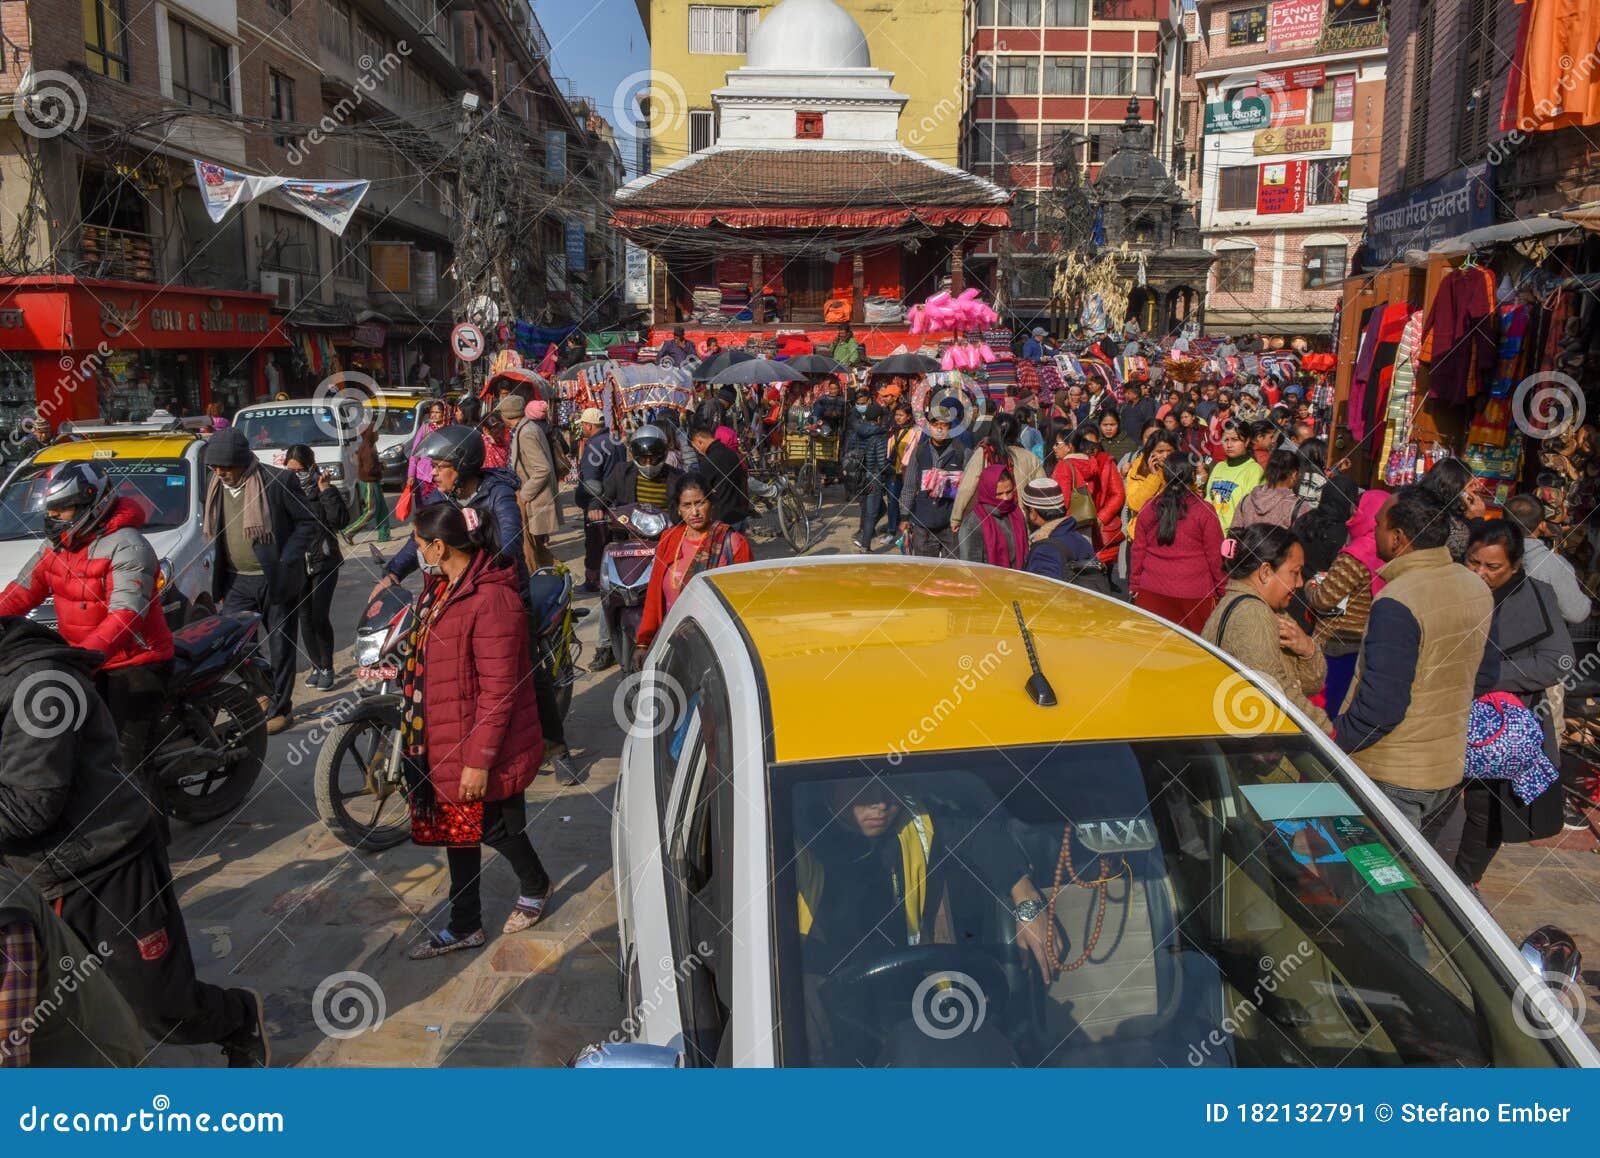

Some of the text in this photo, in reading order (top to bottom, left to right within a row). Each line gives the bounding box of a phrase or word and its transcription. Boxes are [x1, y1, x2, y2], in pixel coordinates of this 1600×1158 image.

[1273, 4, 1320, 18] PENNY
[1273, 12, 1319, 27] LANE
[1286, 127, 1328, 140] SAMAR
[1285, 139, 1326, 151] GROUP
[152, 309, 182, 331] GOLD
[188, 311, 196, 331] &
[255, 407, 316, 418] SUZUKI
[1079, 818, 1151, 845] TAXI
